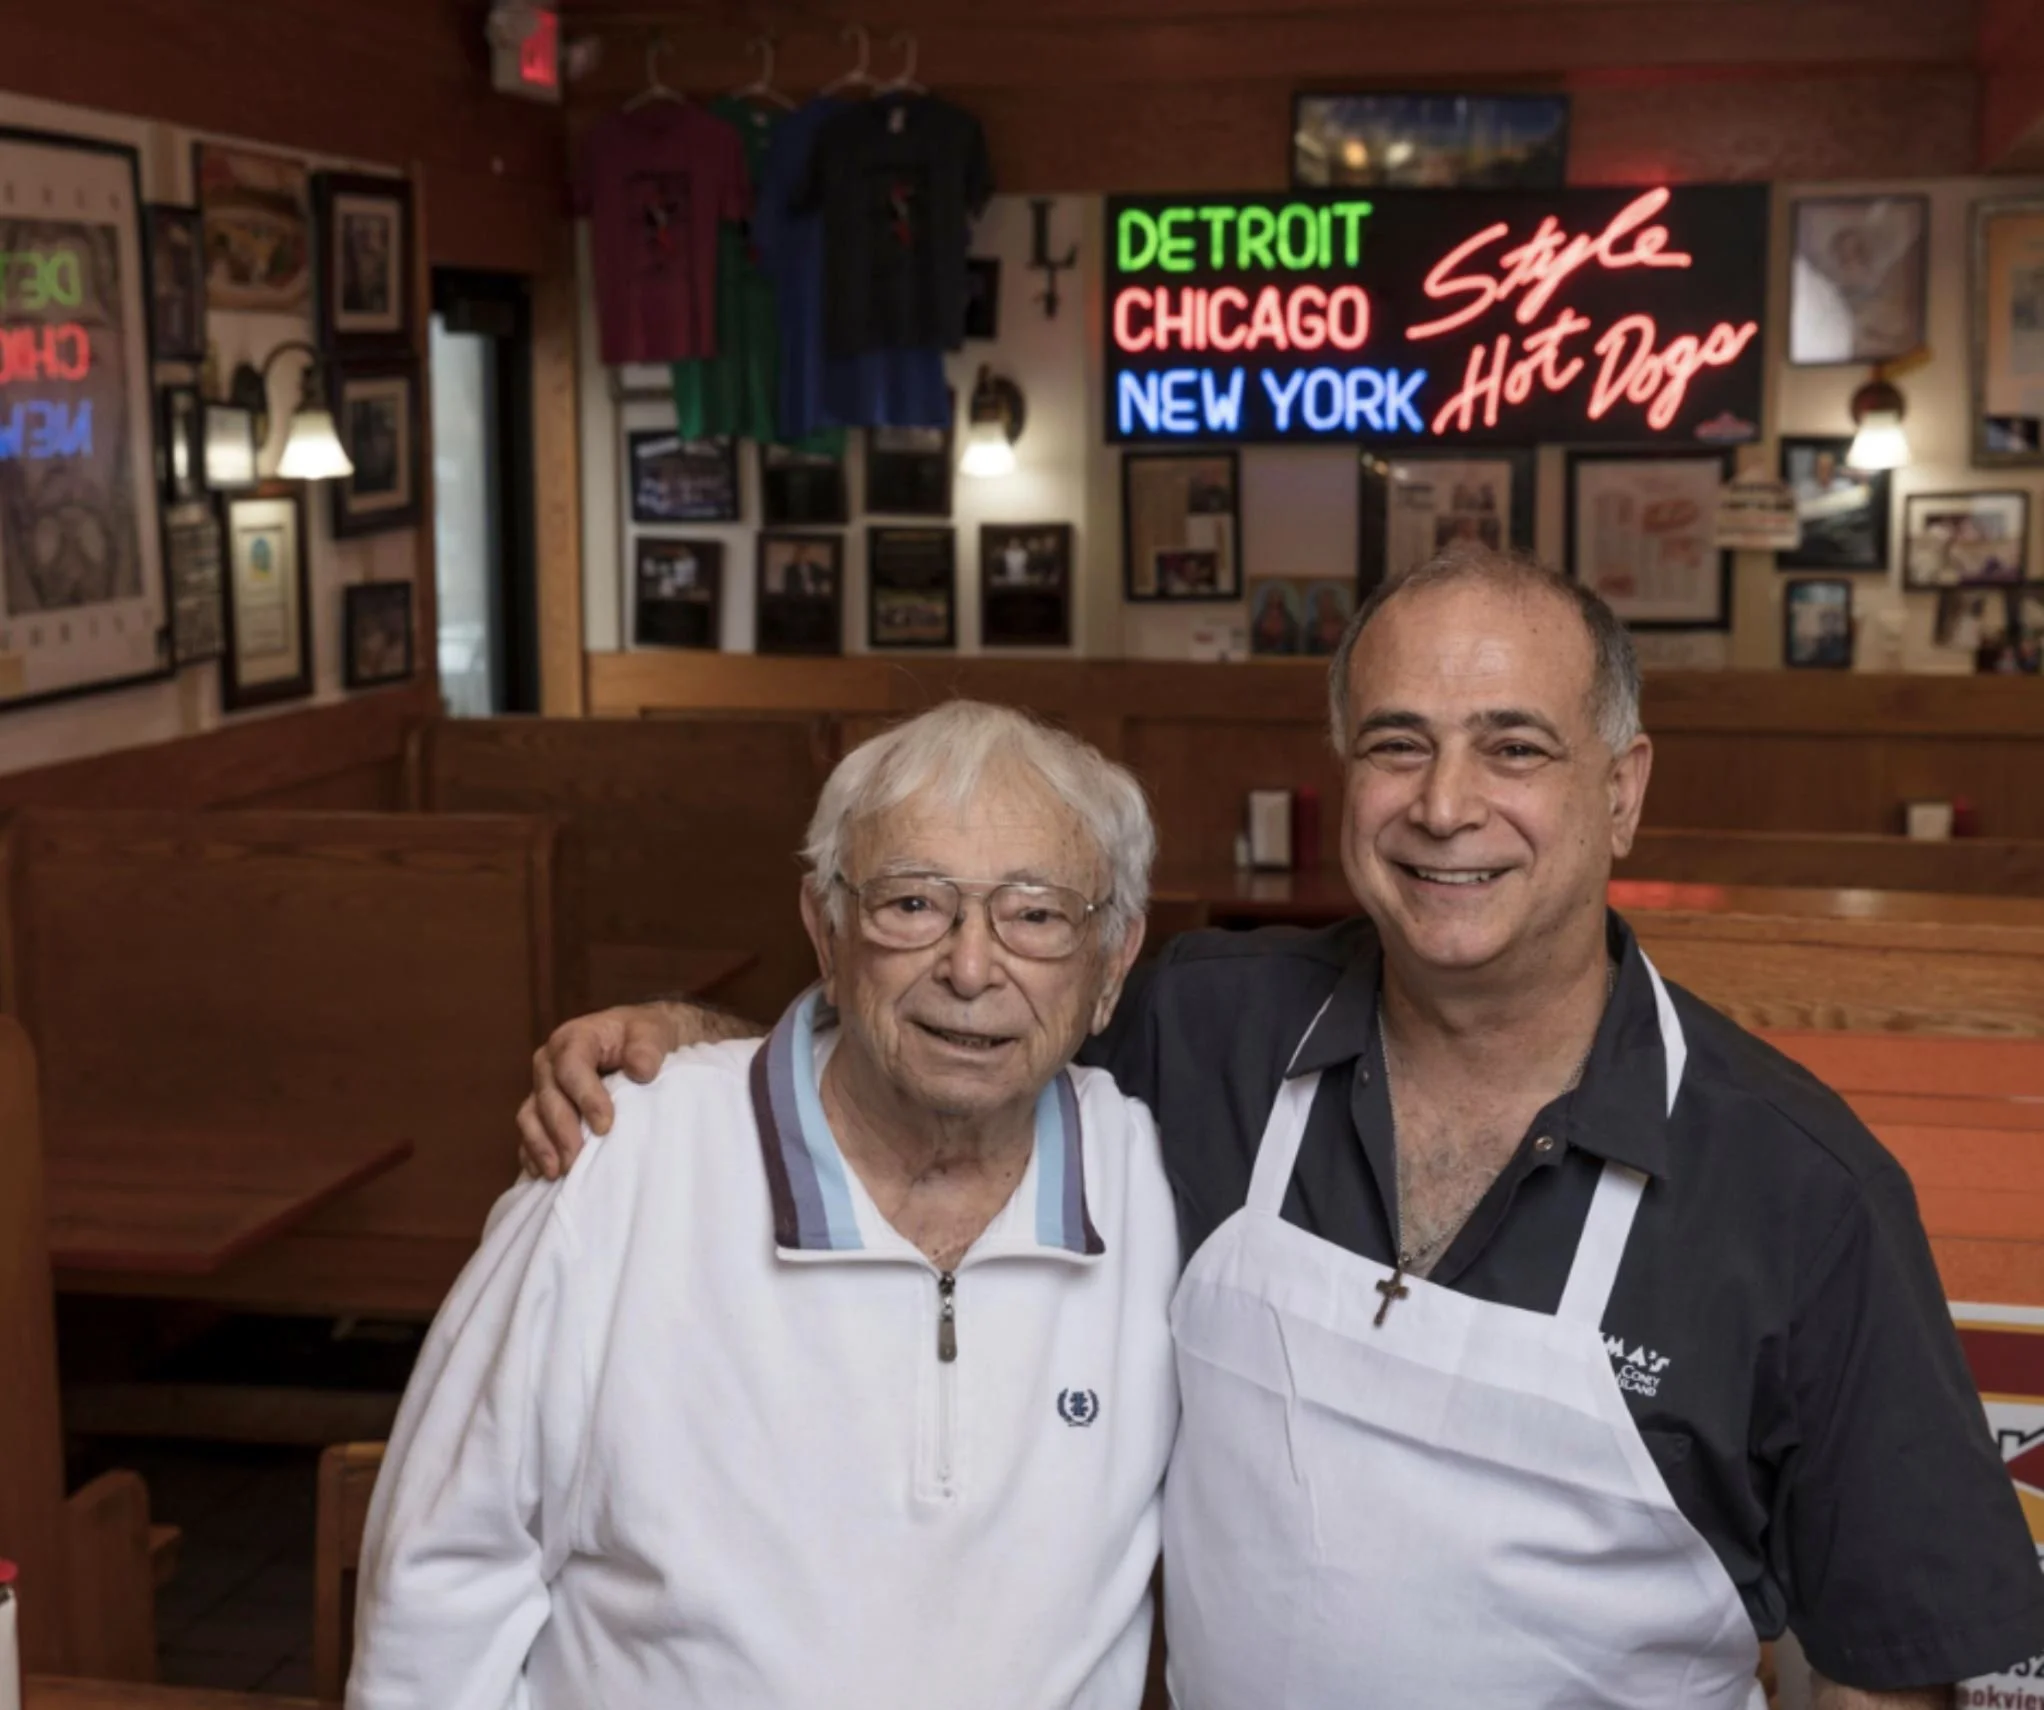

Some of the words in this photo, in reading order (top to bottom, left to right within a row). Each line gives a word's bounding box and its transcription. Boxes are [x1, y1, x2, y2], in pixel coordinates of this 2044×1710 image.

[1117, 201, 1373, 271] DETROIT
[1404, 185, 1693, 341] Style
[1112, 283, 1371, 354] CHICAGO
[1117, 366, 1246, 434] NEW
[1260, 365, 1428, 434] YORK
[1432, 307, 1591, 435] Hot
[1587, 312, 1758, 431] Dogs
[1600, 1332, 1671, 1373] MA'S
